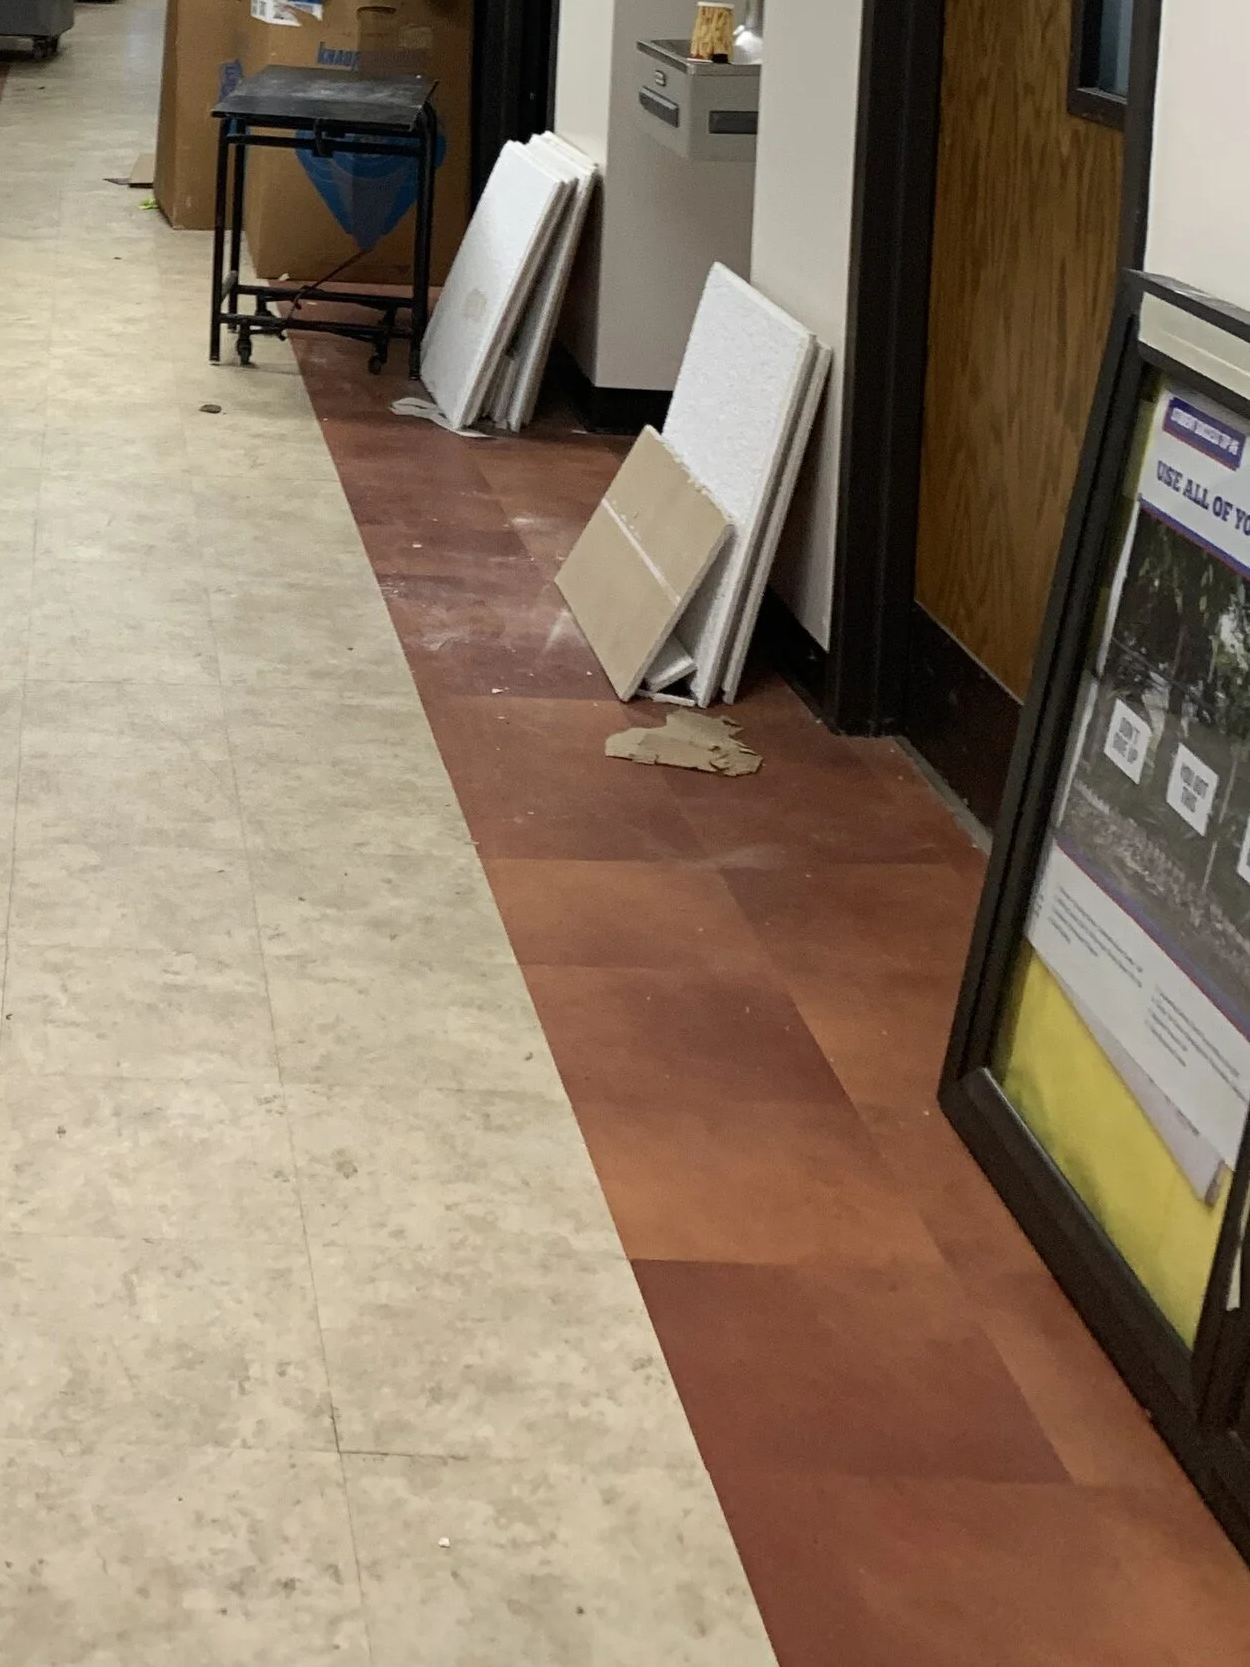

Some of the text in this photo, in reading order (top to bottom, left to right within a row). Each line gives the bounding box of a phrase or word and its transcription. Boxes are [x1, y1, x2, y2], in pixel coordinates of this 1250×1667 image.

[1157, 460, 1183, 492] USE
[1183, 478, 1210, 510] ALL
[1212, 496, 1234, 522] OF
